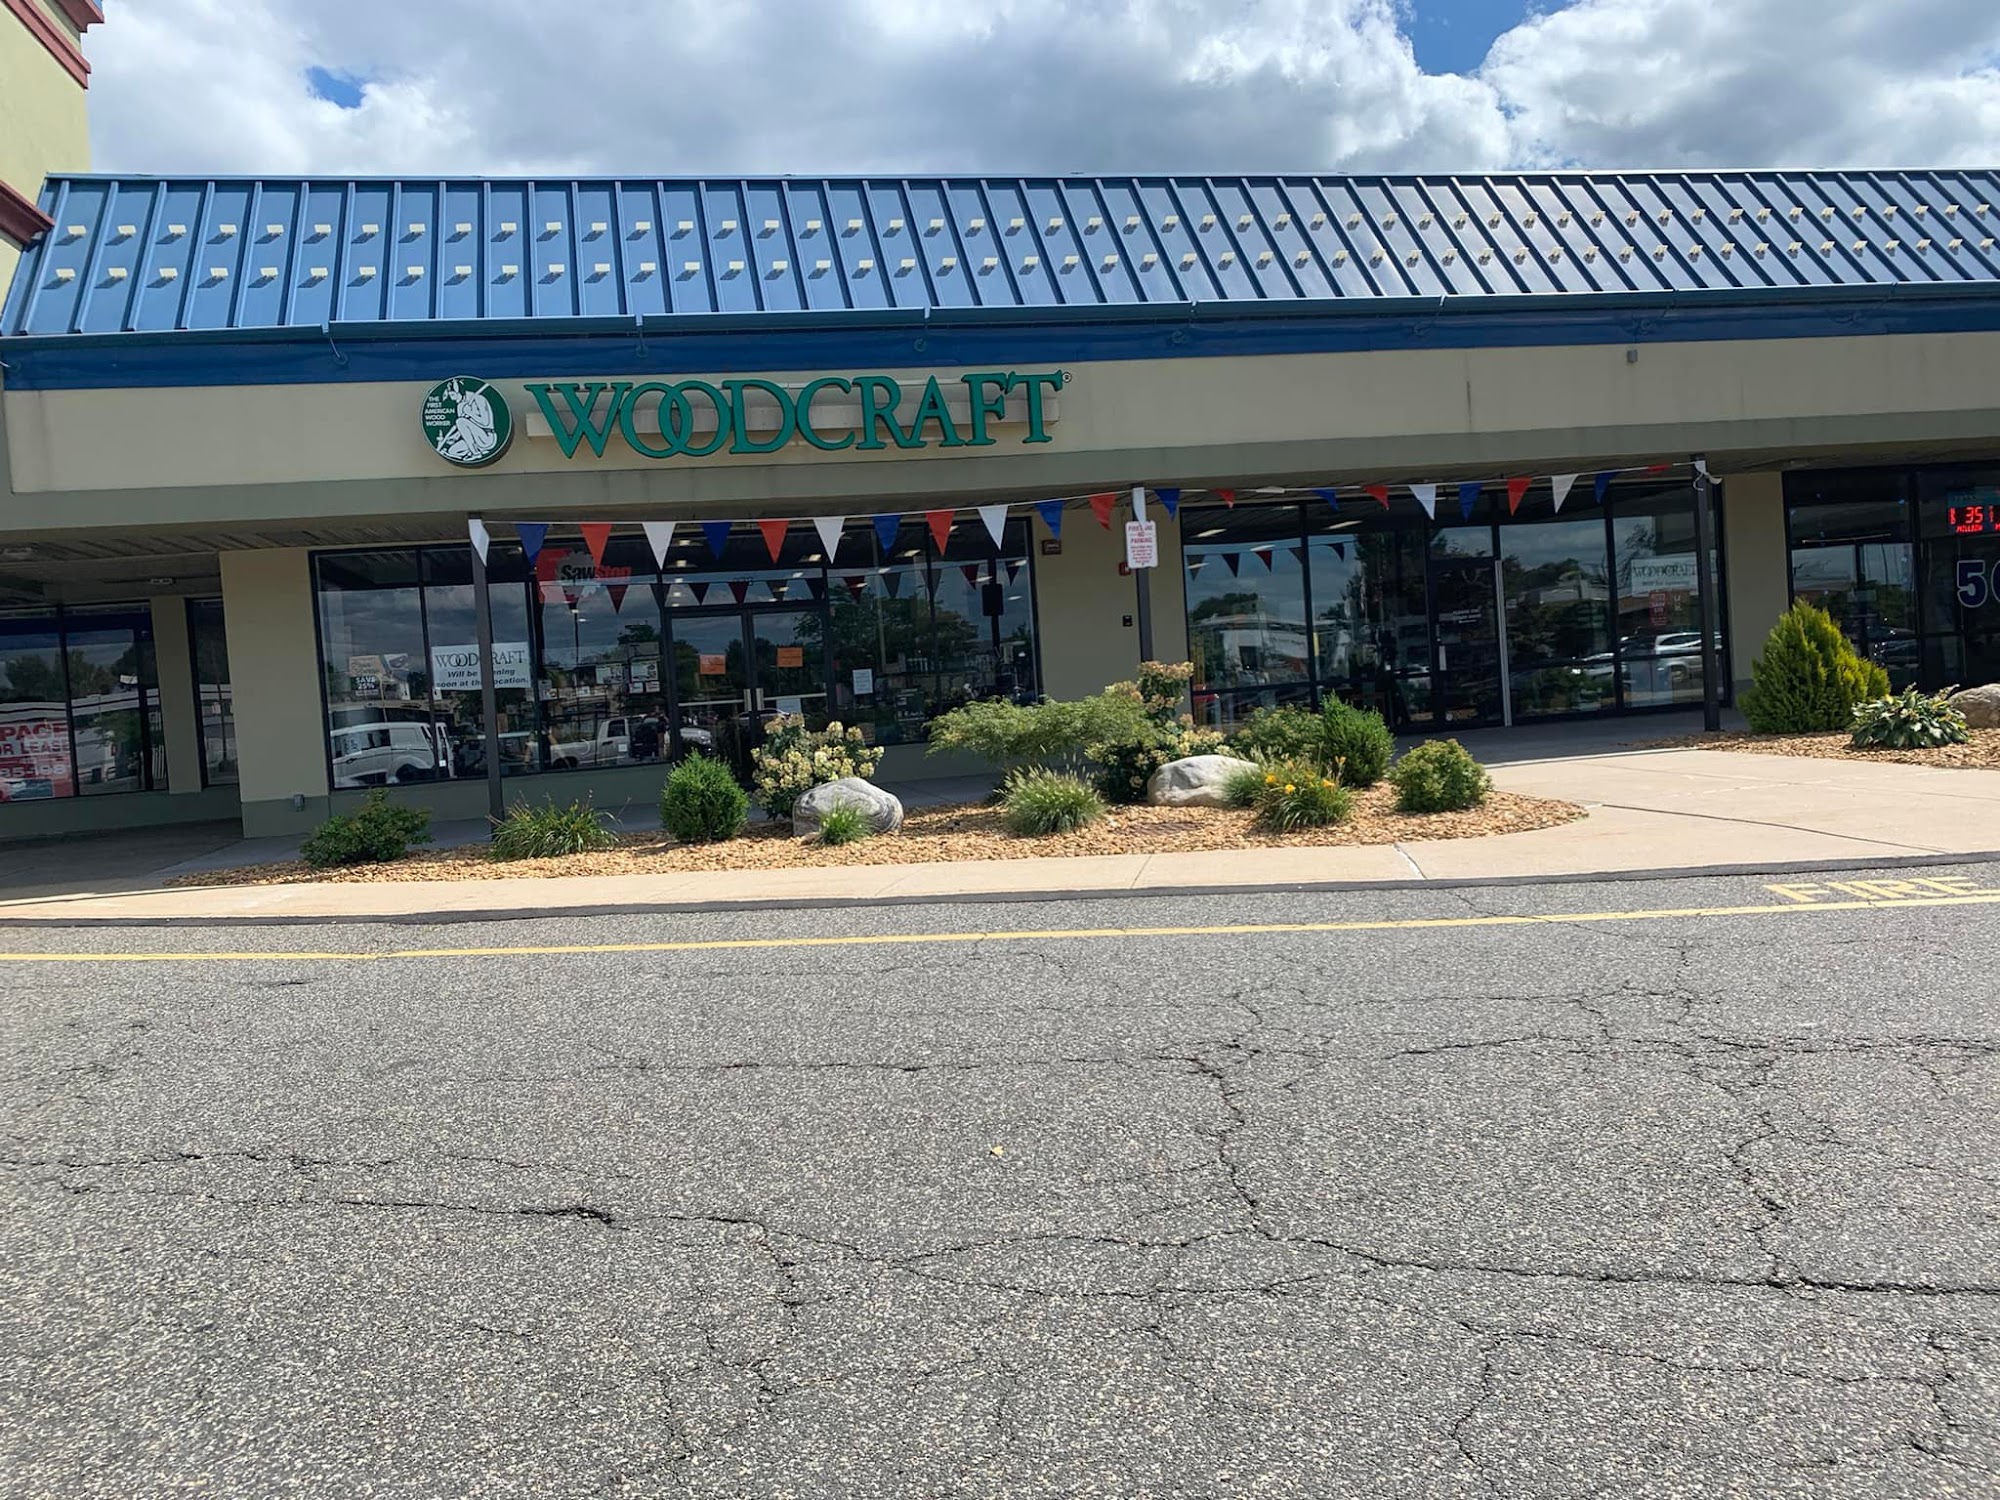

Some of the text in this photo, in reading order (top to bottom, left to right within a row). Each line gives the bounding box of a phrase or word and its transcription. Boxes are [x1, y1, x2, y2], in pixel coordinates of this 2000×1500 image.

[524, 370, 1063, 458] WOODCRAFT
[434, 650, 525, 668] WOODRAFT
[447, 670, 465, 678] Will
[466, 669, 478, 677] be
[493, 678, 528, 686] ocation.
[1762, 876, 2000, 903] FIRE
